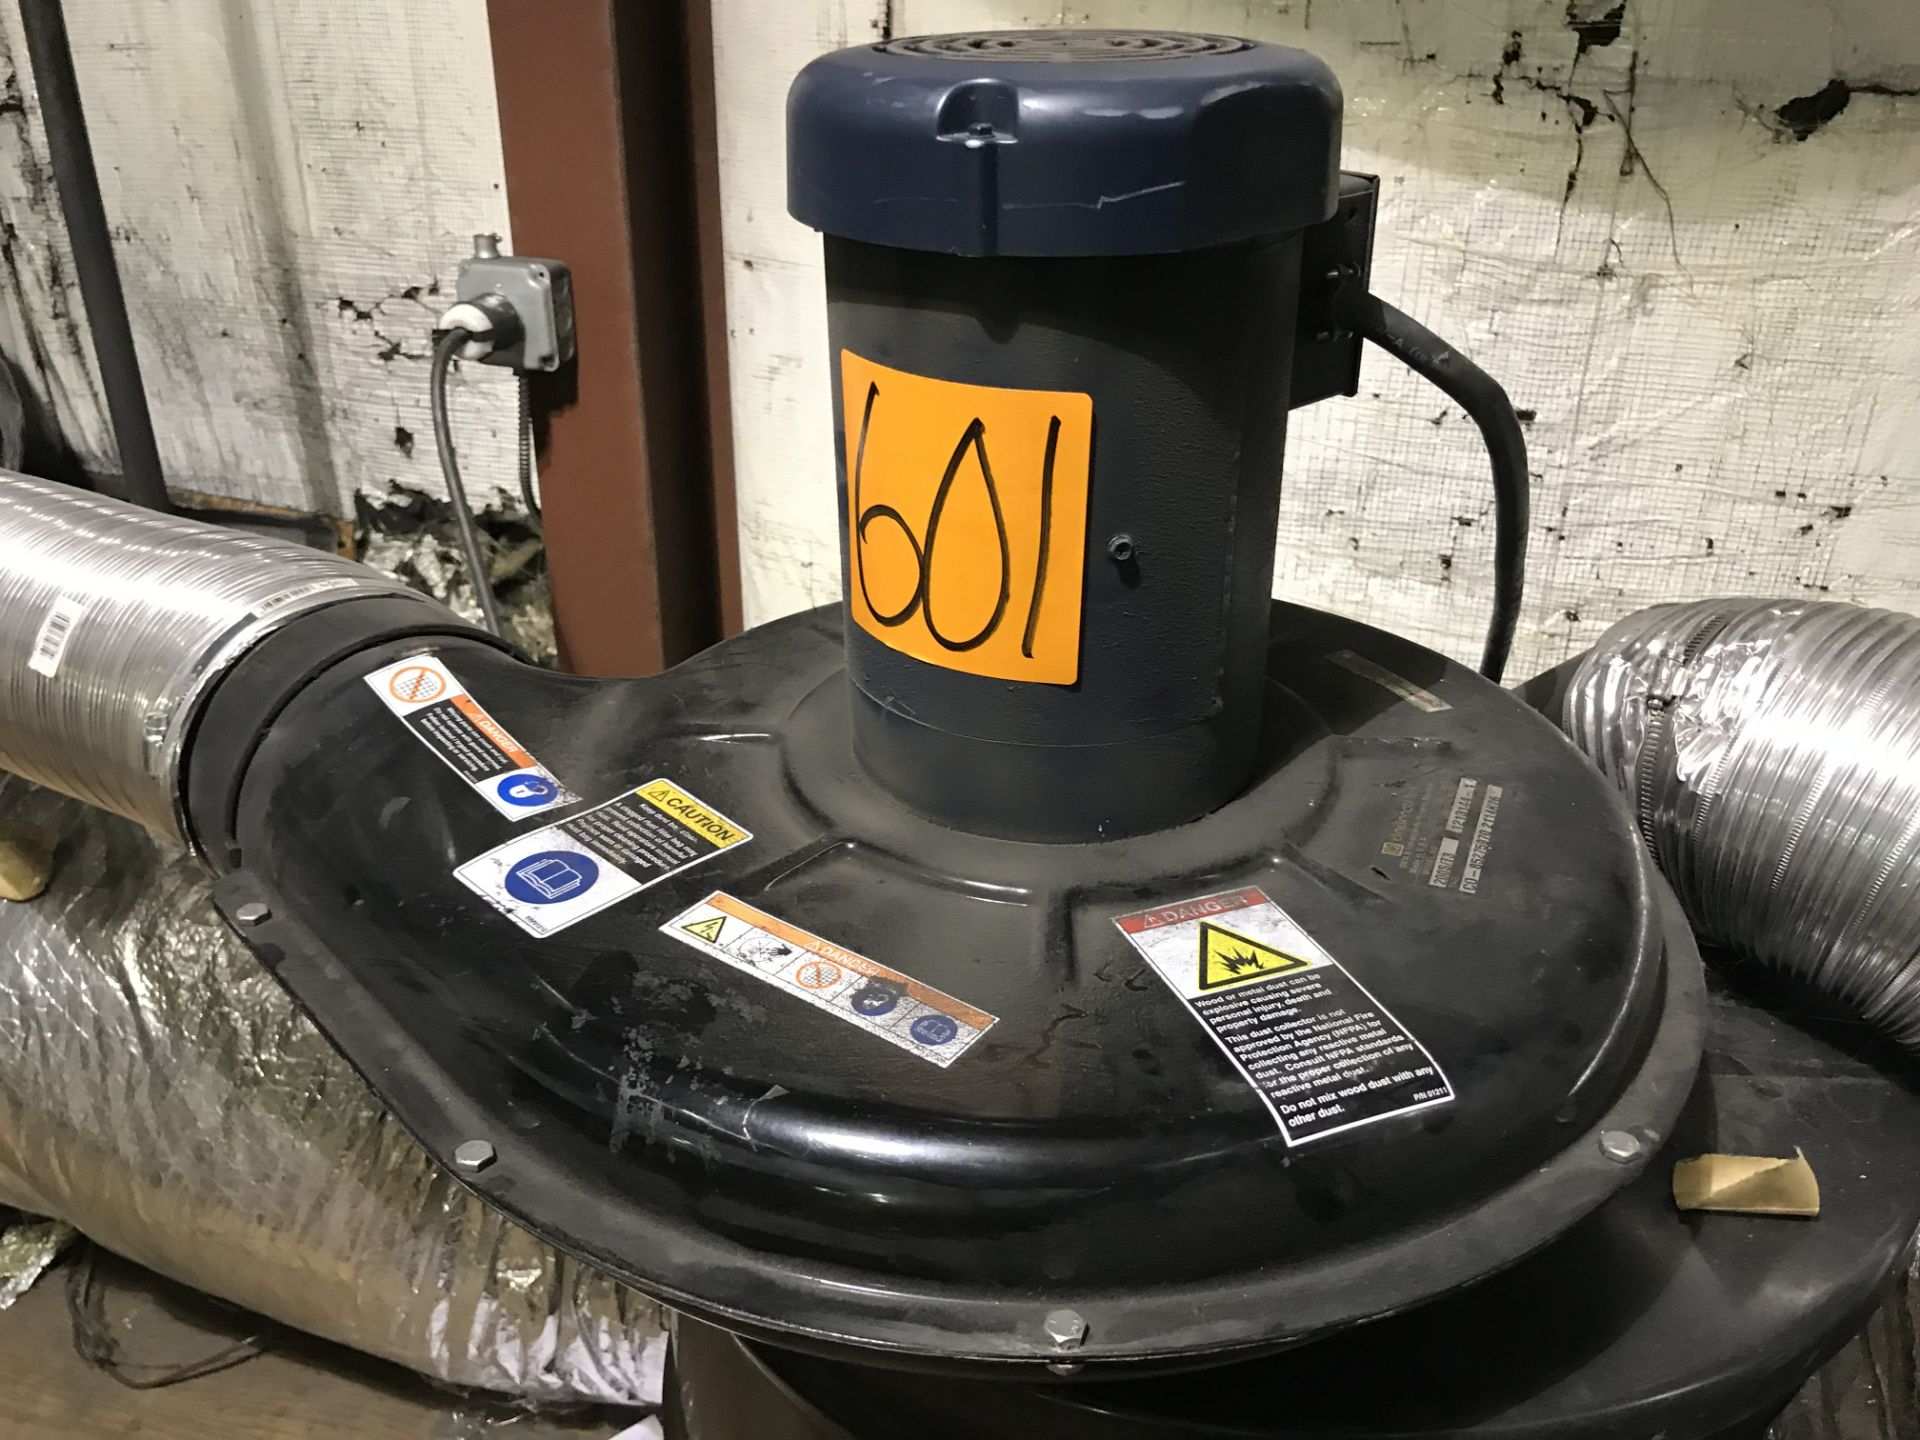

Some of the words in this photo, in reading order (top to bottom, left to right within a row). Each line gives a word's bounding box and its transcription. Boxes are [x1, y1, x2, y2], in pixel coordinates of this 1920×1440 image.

[855, 381, 1061, 659] 601
[479, 721, 518, 753] DANGER
[666, 797, 734, 841] CAUTION
[670, 837, 685, 848] bag
[1194, 996, 1225, 1007] Wood
[1237, 986, 1265, 998] metal
[1266, 981, 1289, 991] dust
[1288, 977, 1308, 985] can
[1202, 1000, 1249, 1016] explosive
[1250, 991, 1290, 1004] causing
[1289, 983, 1322, 994] severe
[1209, 1008, 1253, 1025] personal
[1252, 1002, 1285, 1013] injury,
[1284, 994, 1313, 1005] death
[1313, 988, 1332, 998] and
[1216, 1017, 1258, 1033] property
[1259, 1007, 1302, 1021] damage.
[1224, 1034, 1249, 1043] This
[1249, 1027, 1273, 1038] dust
[1273, 1017, 1316, 1032] collector
[1328, 1008, 1346, 1018] not
[1233, 1035, 1281, 1053] approved
[1294, 1028, 1313, 1036] the
[1312, 1016, 1354, 1032] National
[1353, 1012, 1375, 1021] Fire
[1239, 1043, 1293, 1061] Protection
[1294, 1033, 1332, 1048] Agency
[1332, 1023, 1368, 1037] (NFPA)
[1366, 1020, 1382, 1028] for
[1248, 1053, 1299, 1070] collecting
[1298, 1048, 1317, 1057] any
[1318, 1037, 1358, 1051] reactive
[1358, 1028, 1387, 1040] metal
[1255, 1067, 1283, 1079] dust.
[1284, 1055, 1326, 1071] Consult
[1324, 1047, 1355, 1060] NFPA
[1355, 1035, 1403, 1052] standards
[1278, 1075, 1297, 1084] the
[1297, 1065, 1331, 1081] proper
[1332, 1052, 1382, 1069] collection
[1393, 1044, 1413, 1052] any
[1270, 1082, 1312, 1098] reactive
[1312, 1072, 1342, 1086] metal
[1297, 1097, 1317, 1109] not
[1317, 1092, 1338, 1104] mix
[1337, 1082, 1368, 1097] wood
[1367, 1076, 1392, 1089] dust
[1391, 1070, 1415, 1082] with
[1414, 1067, 1434, 1077] any
[1413, 1092, 1427, 1101] P/N
[1288, 1112, 1316, 1127] other
[1317, 1104, 1345, 1118] dust.
